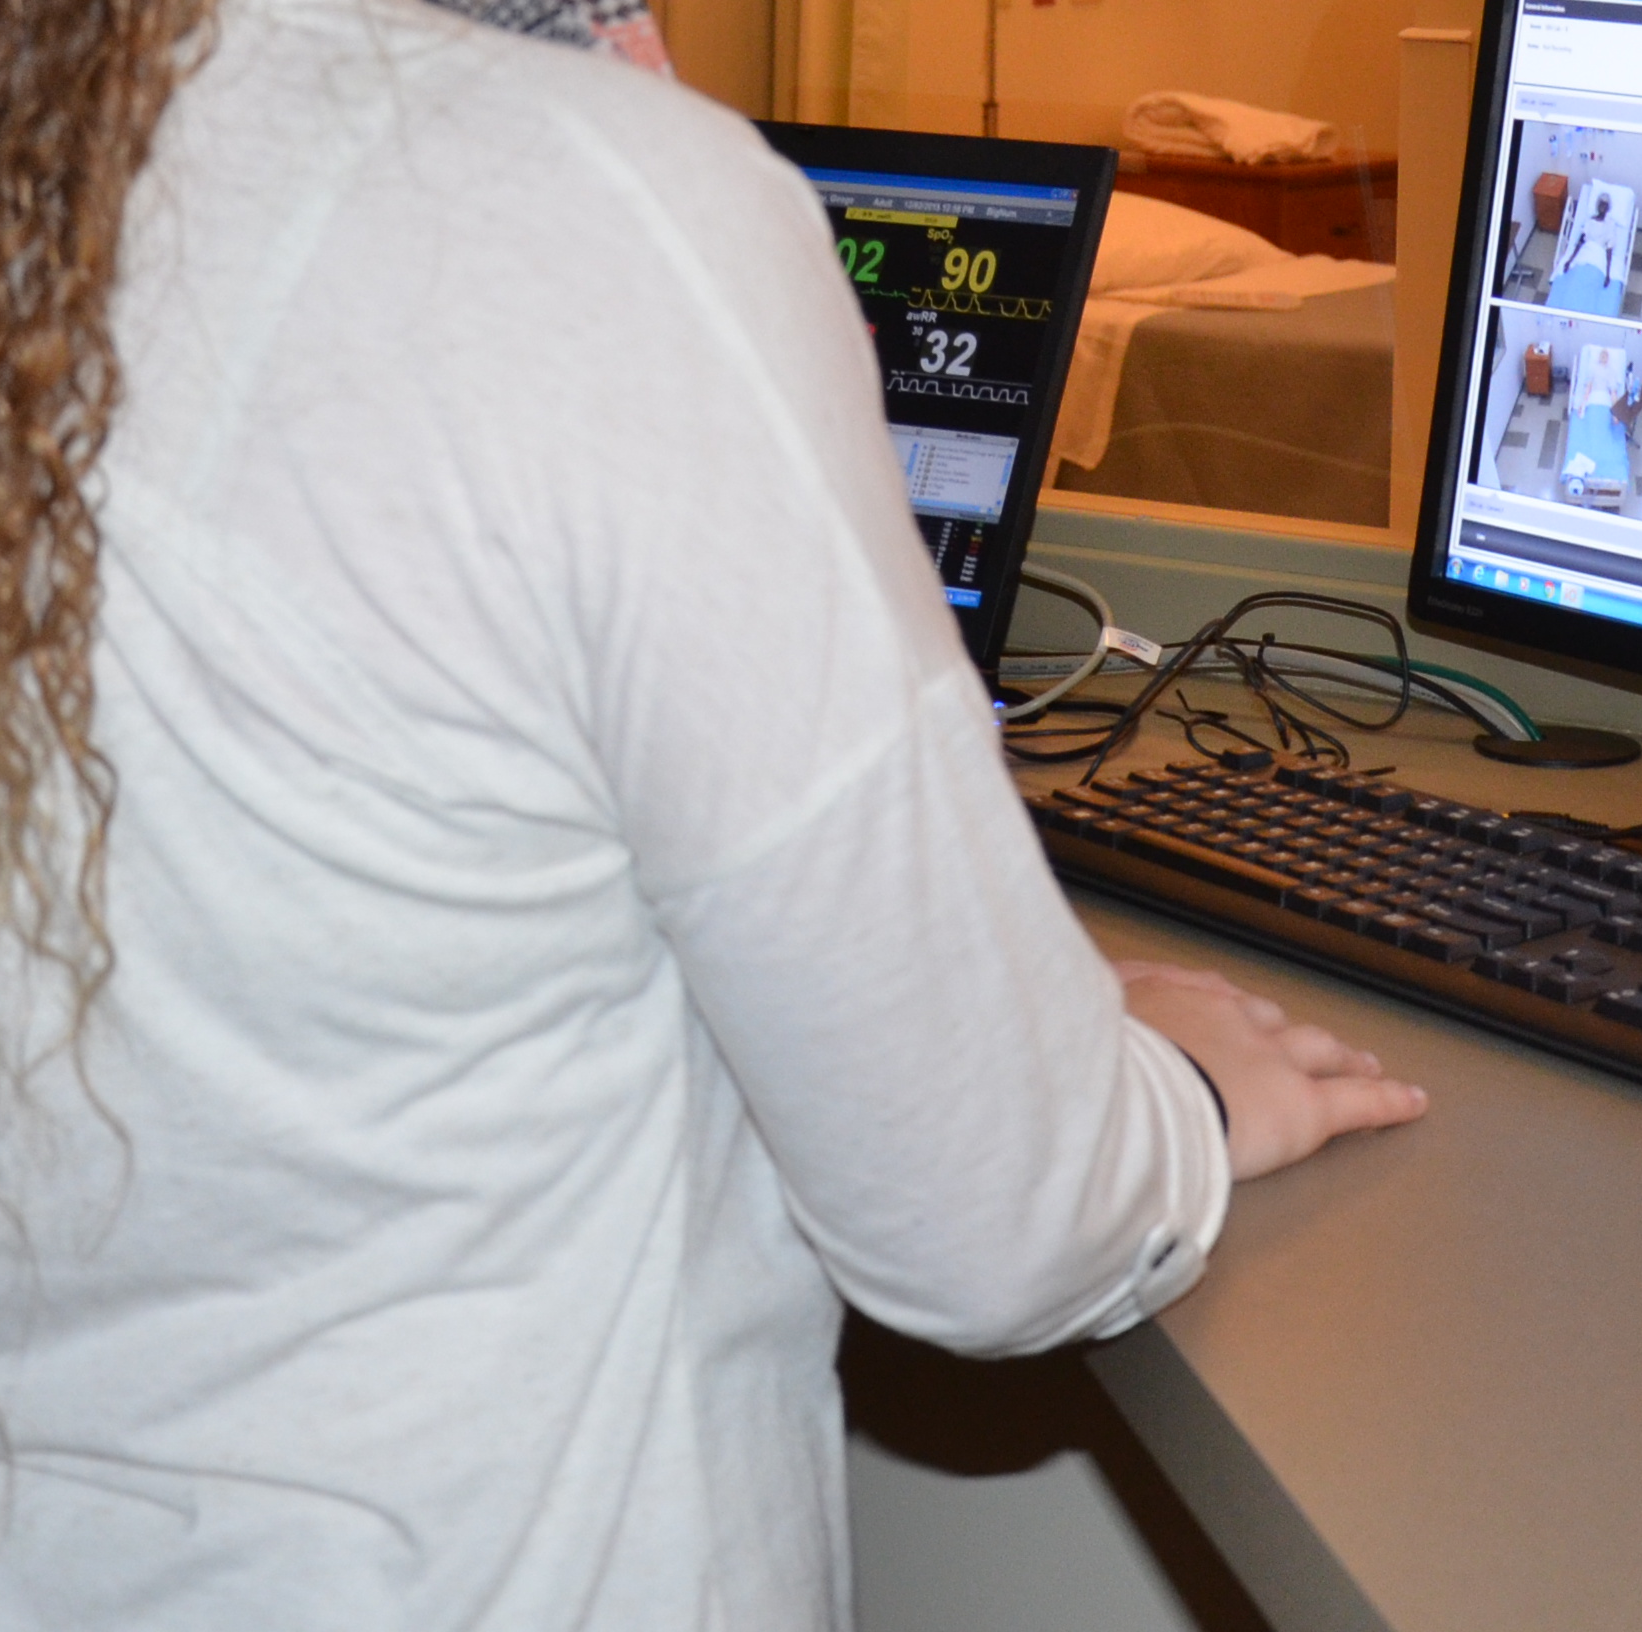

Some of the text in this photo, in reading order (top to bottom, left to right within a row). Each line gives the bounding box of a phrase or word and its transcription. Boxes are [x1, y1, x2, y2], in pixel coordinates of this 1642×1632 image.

[940, 247, 997, 293] 90
[906, 311, 937, 324] awRR
[911, 325, 924, 337] 30
[919, 329, 979, 377] 32
